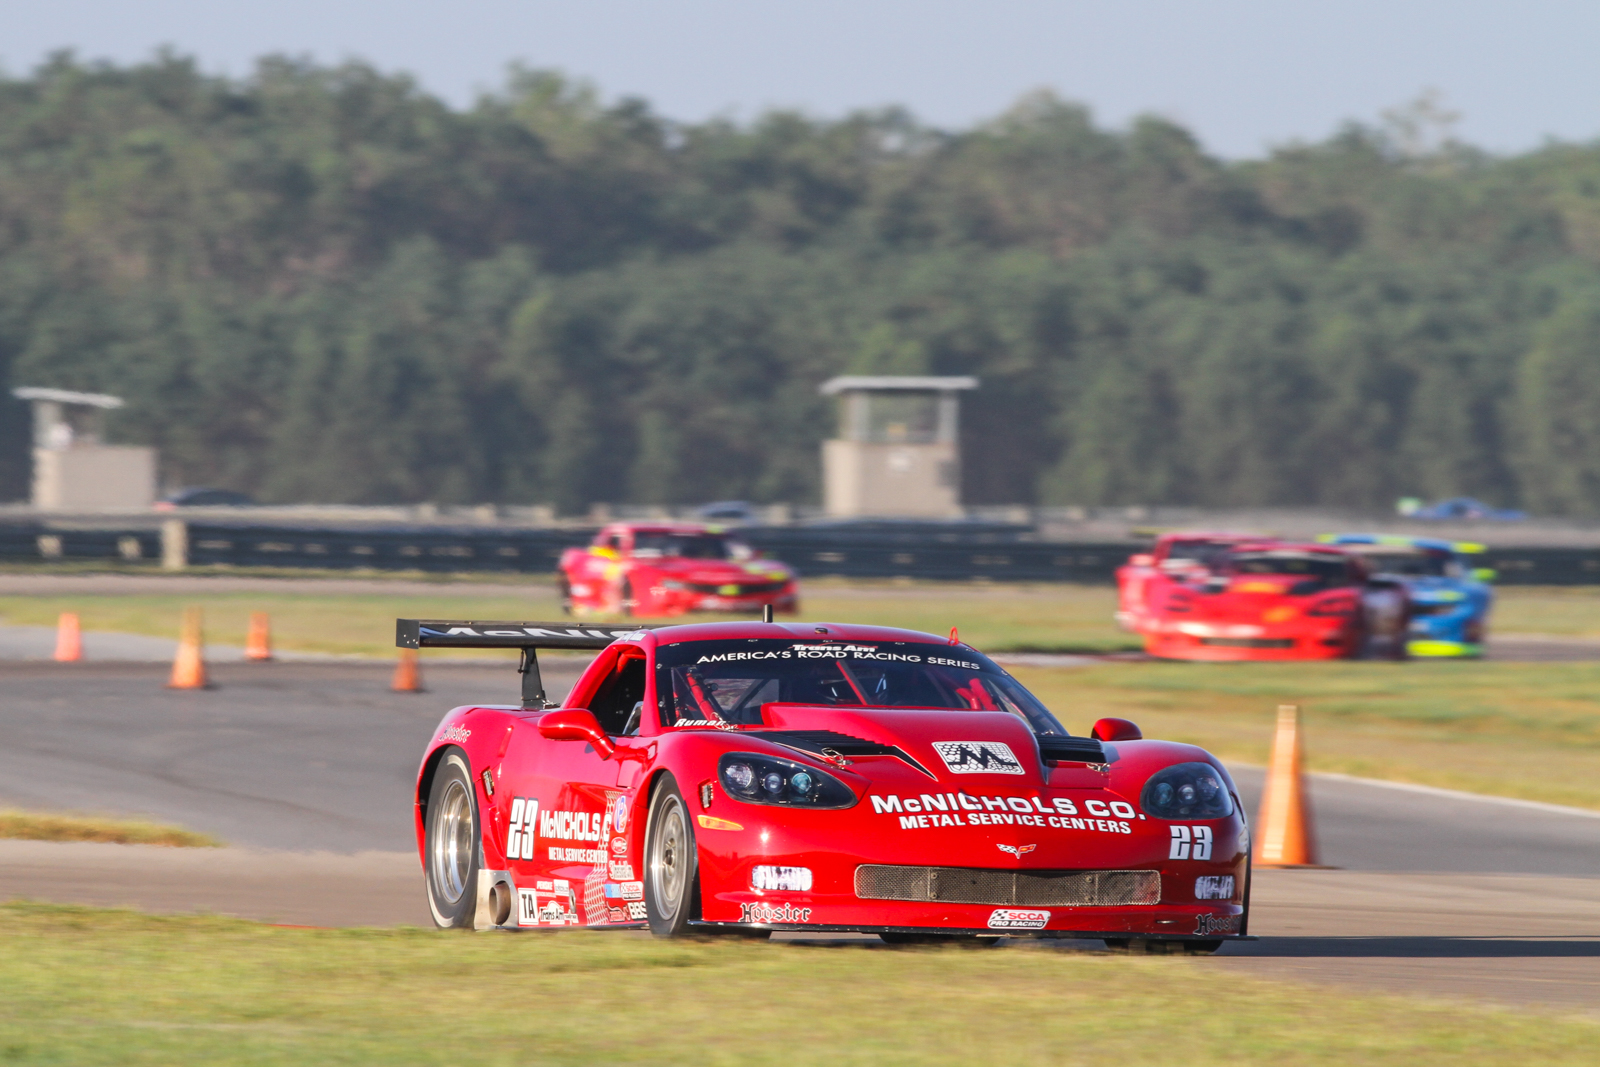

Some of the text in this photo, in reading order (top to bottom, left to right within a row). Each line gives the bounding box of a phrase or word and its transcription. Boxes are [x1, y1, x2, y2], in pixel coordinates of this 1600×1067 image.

[792, 643, 876, 653] Trans Am
[697, 650, 980, 670] AMERICA'S ROAD RACING SERIES
[870, 792, 1147, 820] McNICHOLS CO.
[506, 797, 539, 861] 23
[540, 809, 601, 842] McNICHOLS
[898, 813, 1132, 835] METAL SERVICE CENTERS
[1168, 824, 1214, 861] 23
[548, 846, 566, 861] METAL
[565, 847, 587, 862] SERVICE
[521, 893, 537, 920] TA
[627, 901, 648, 920] BBS
[739, 903, 812, 923] Hoosier
[1008, 912, 1045, 921] SCCA
